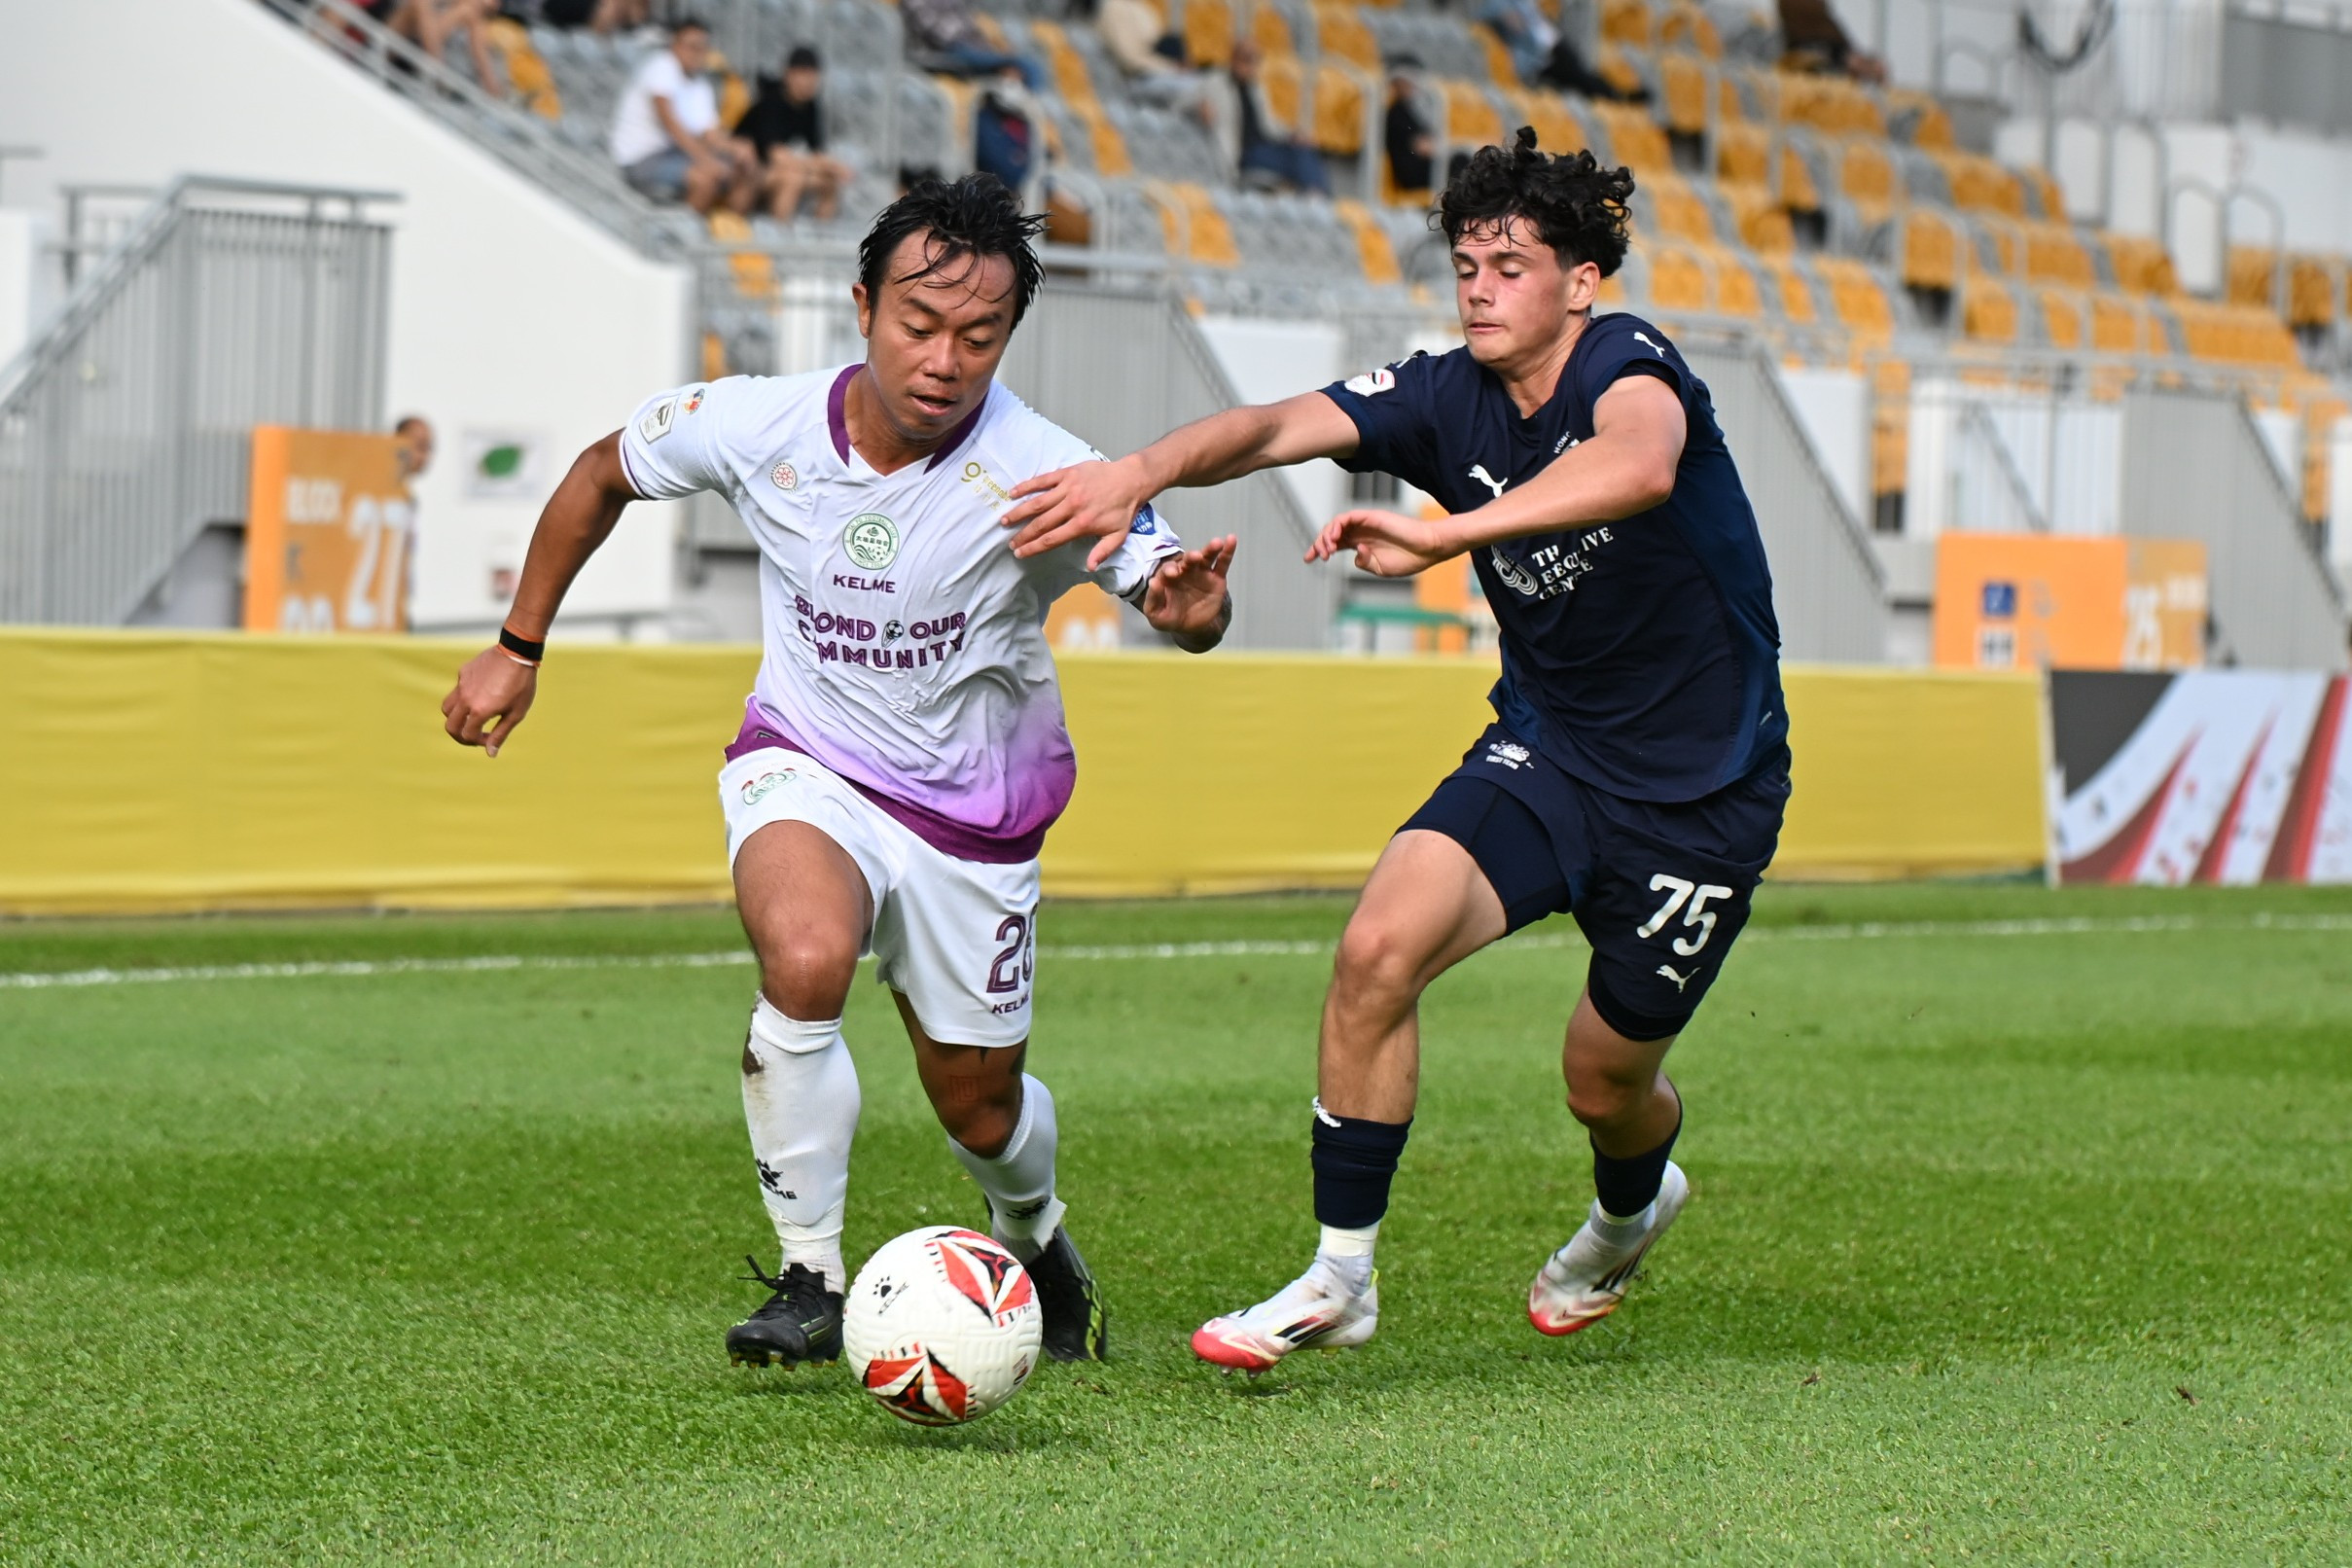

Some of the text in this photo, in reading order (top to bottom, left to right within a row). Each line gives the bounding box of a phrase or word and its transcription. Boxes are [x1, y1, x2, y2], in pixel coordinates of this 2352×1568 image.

[348, 496, 412, 629] 27
[1531, 545, 1559, 567] TH
[1541, 526, 1614, 585] EECUIVE
[833, 574, 896, 594] KELME
[798, 619, 966, 669] CMMUNITY
[909, 611, 967, 640] OUR
[1637, 873, 1732, 956] 75
